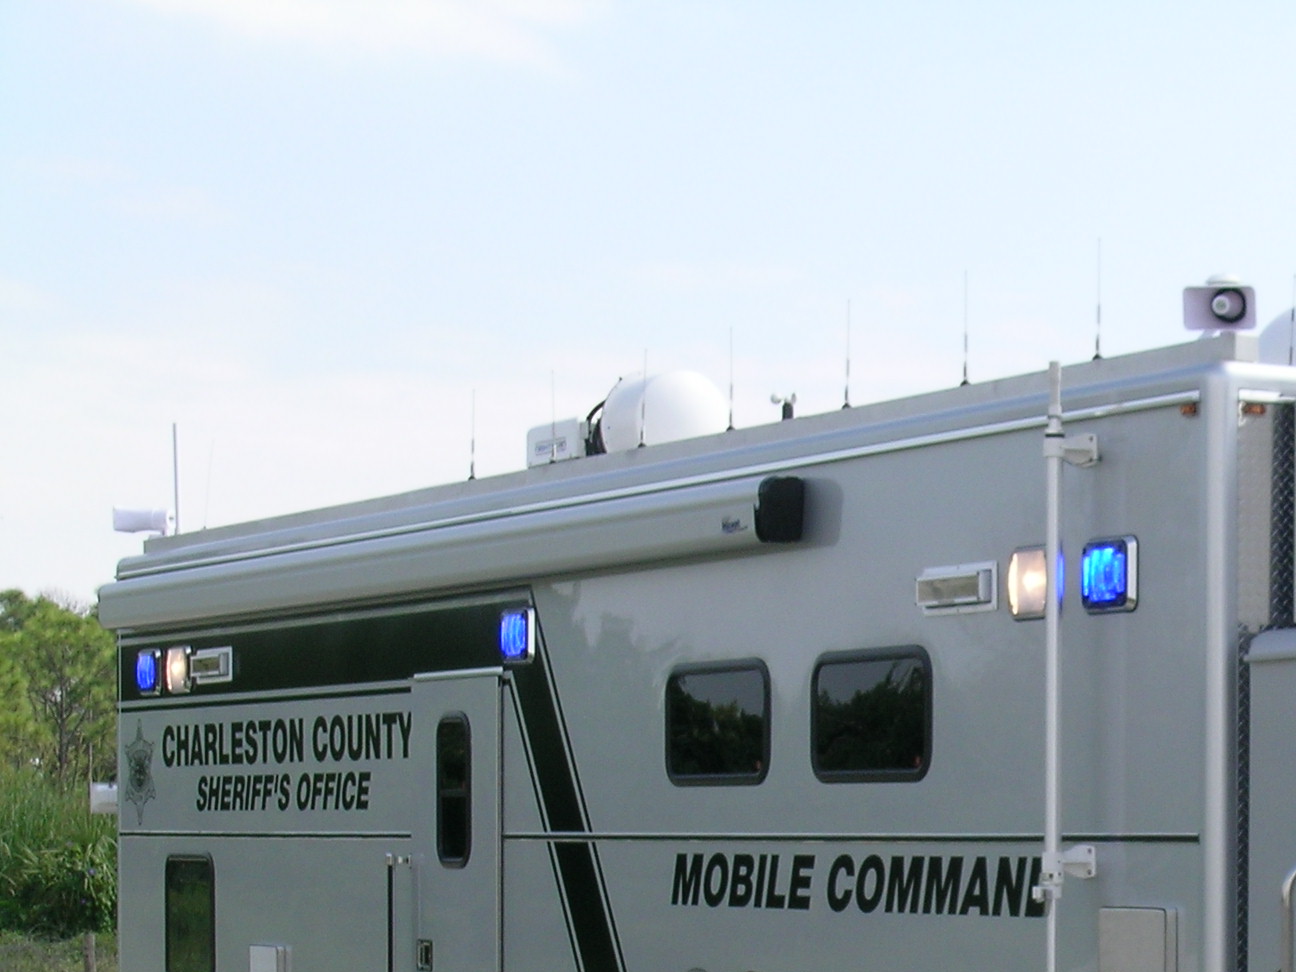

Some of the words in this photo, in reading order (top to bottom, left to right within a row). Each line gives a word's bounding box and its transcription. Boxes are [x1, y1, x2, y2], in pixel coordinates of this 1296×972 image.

[163, 718, 303, 767] CHARLESTON
[313, 712, 412, 763] COUNTY
[196, 773, 291, 812] SHERIFF'S
[297, 771, 371, 811] OFFICE
[671, 852, 816, 910] MOBILE
